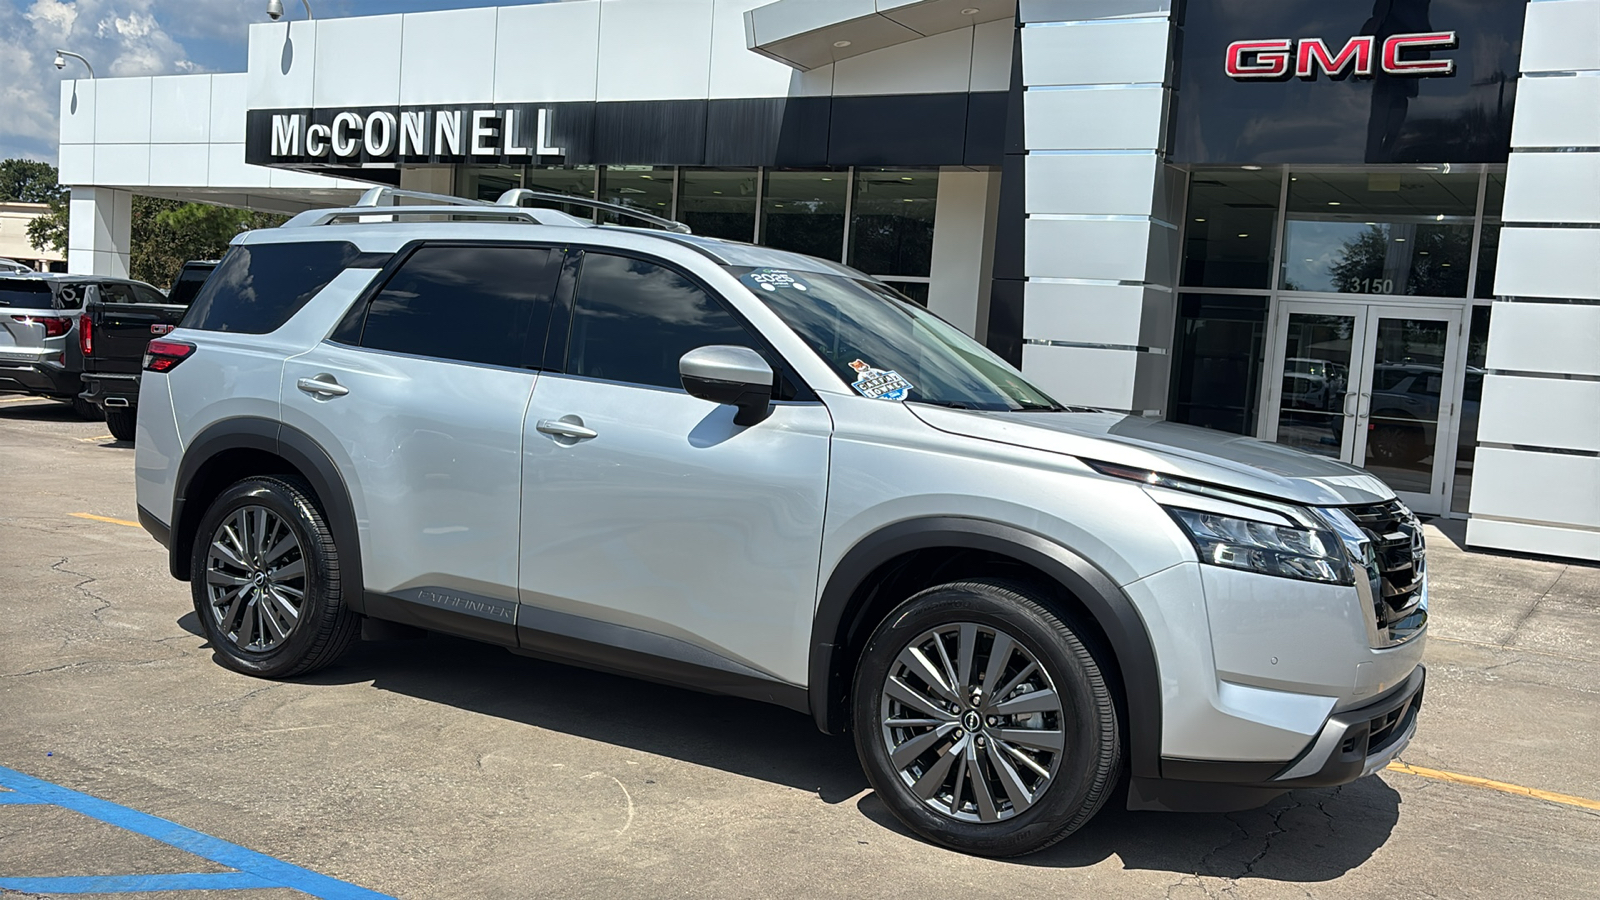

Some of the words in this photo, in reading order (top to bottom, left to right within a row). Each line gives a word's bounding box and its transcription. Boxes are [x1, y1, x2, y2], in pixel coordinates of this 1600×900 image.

[1225, 31, 1456, 77] GMC
[270, 108, 563, 157] McCONNELL
[750, 273, 795, 283] 2025
[1350, 276, 1393, 294] 3150
[418, 590, 512, 618] PATHFINDER
